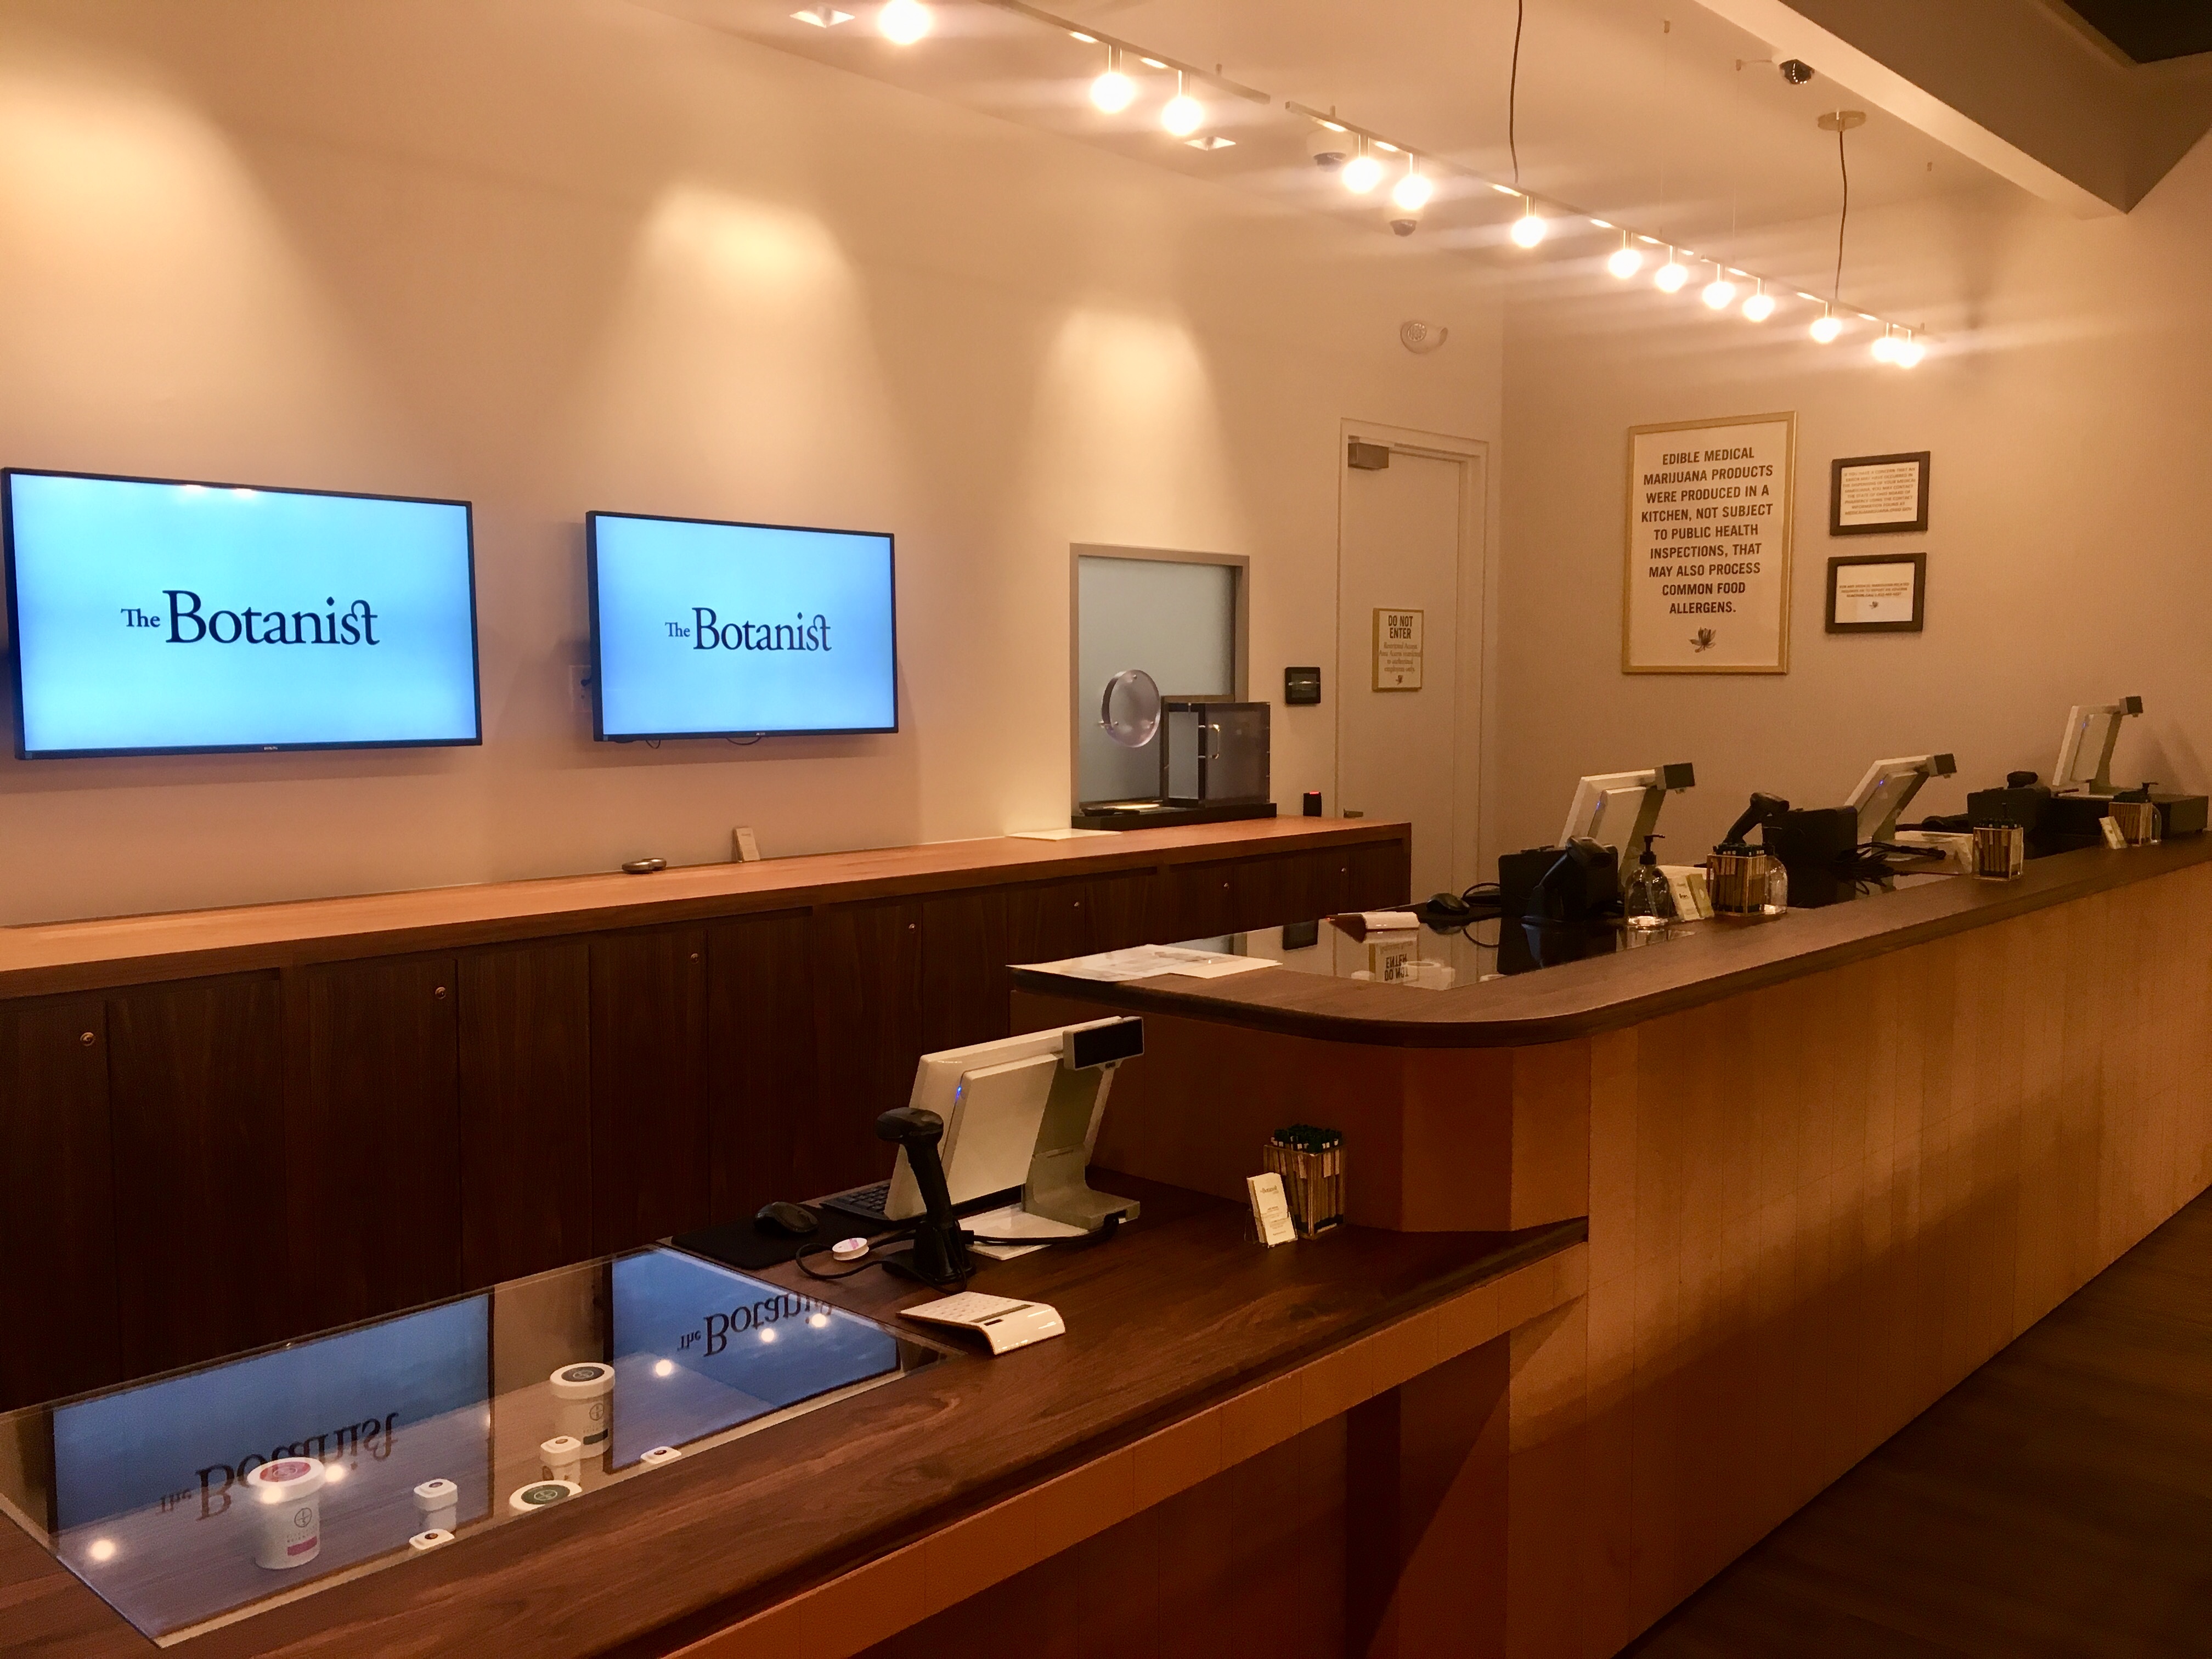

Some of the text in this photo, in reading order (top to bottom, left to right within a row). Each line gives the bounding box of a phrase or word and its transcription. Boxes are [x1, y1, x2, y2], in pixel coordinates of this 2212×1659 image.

[1662, 447, 1754, 465] EDIBLE MEDICAL
[1644, 465, 1773, 485] MARIJUANA PRODUCTS
[1646, 484, 1769, 504] WERE PRODUCED IN A
[1641, 504, 1773, 523] KITCHEN, NOT SUBJECT
[1654, 524, 1758, 540] TO PUBLIC HEALTH
[1650, 543, 1762, 559] INSPECTIONS, THAT
[1649, 562, 1760, 578] MAY ALSO PROCESS
[1662, 582, 1746, 596] COMMON FOOD
[1669, 601, 1736, 614] ALLERGENS.
[121, 590, 380, 645] The Botanist
[1388, 615, 1413, 627] DO NOT
[664, 607, 832, 651] The Botanist
[1390, 627, 1411, 639] ENTER
